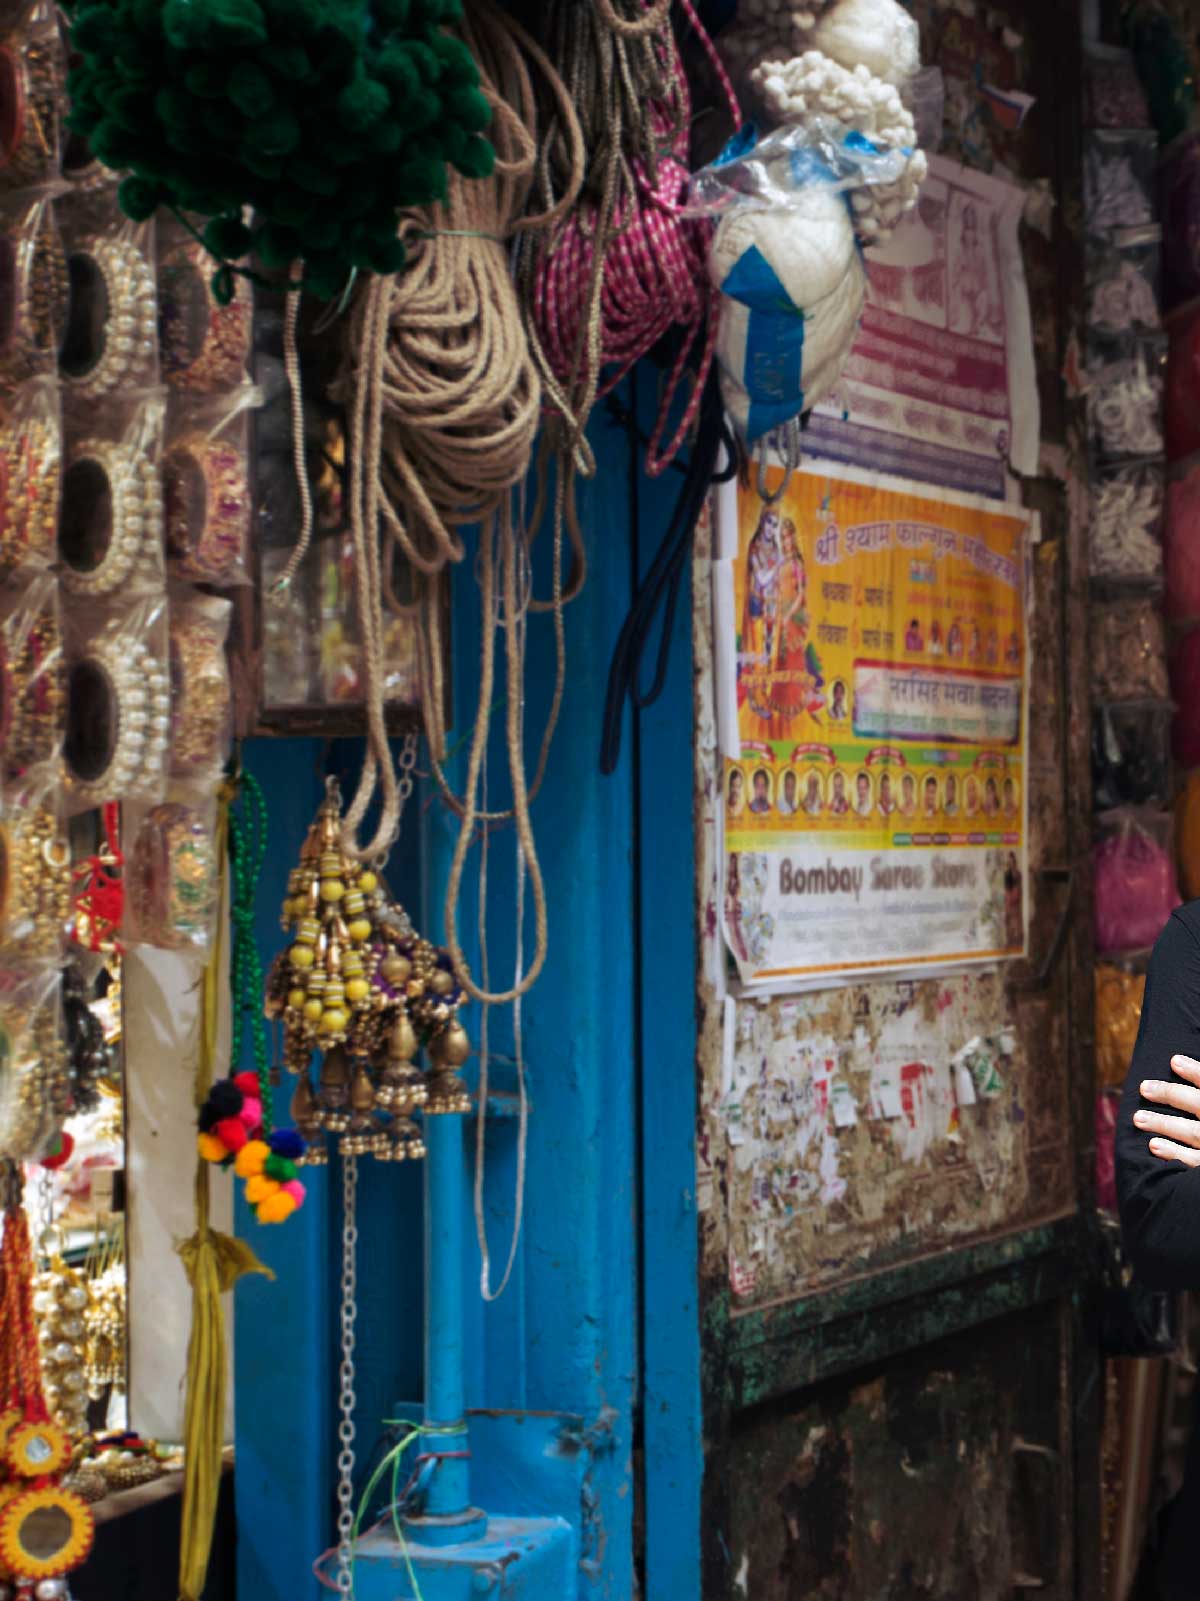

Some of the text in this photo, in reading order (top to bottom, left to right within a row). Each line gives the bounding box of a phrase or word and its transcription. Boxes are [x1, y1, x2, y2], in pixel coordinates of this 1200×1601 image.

[815, 523, 839, 563] श्री
[779, 855, 978, 902] Bombay Saree Store
